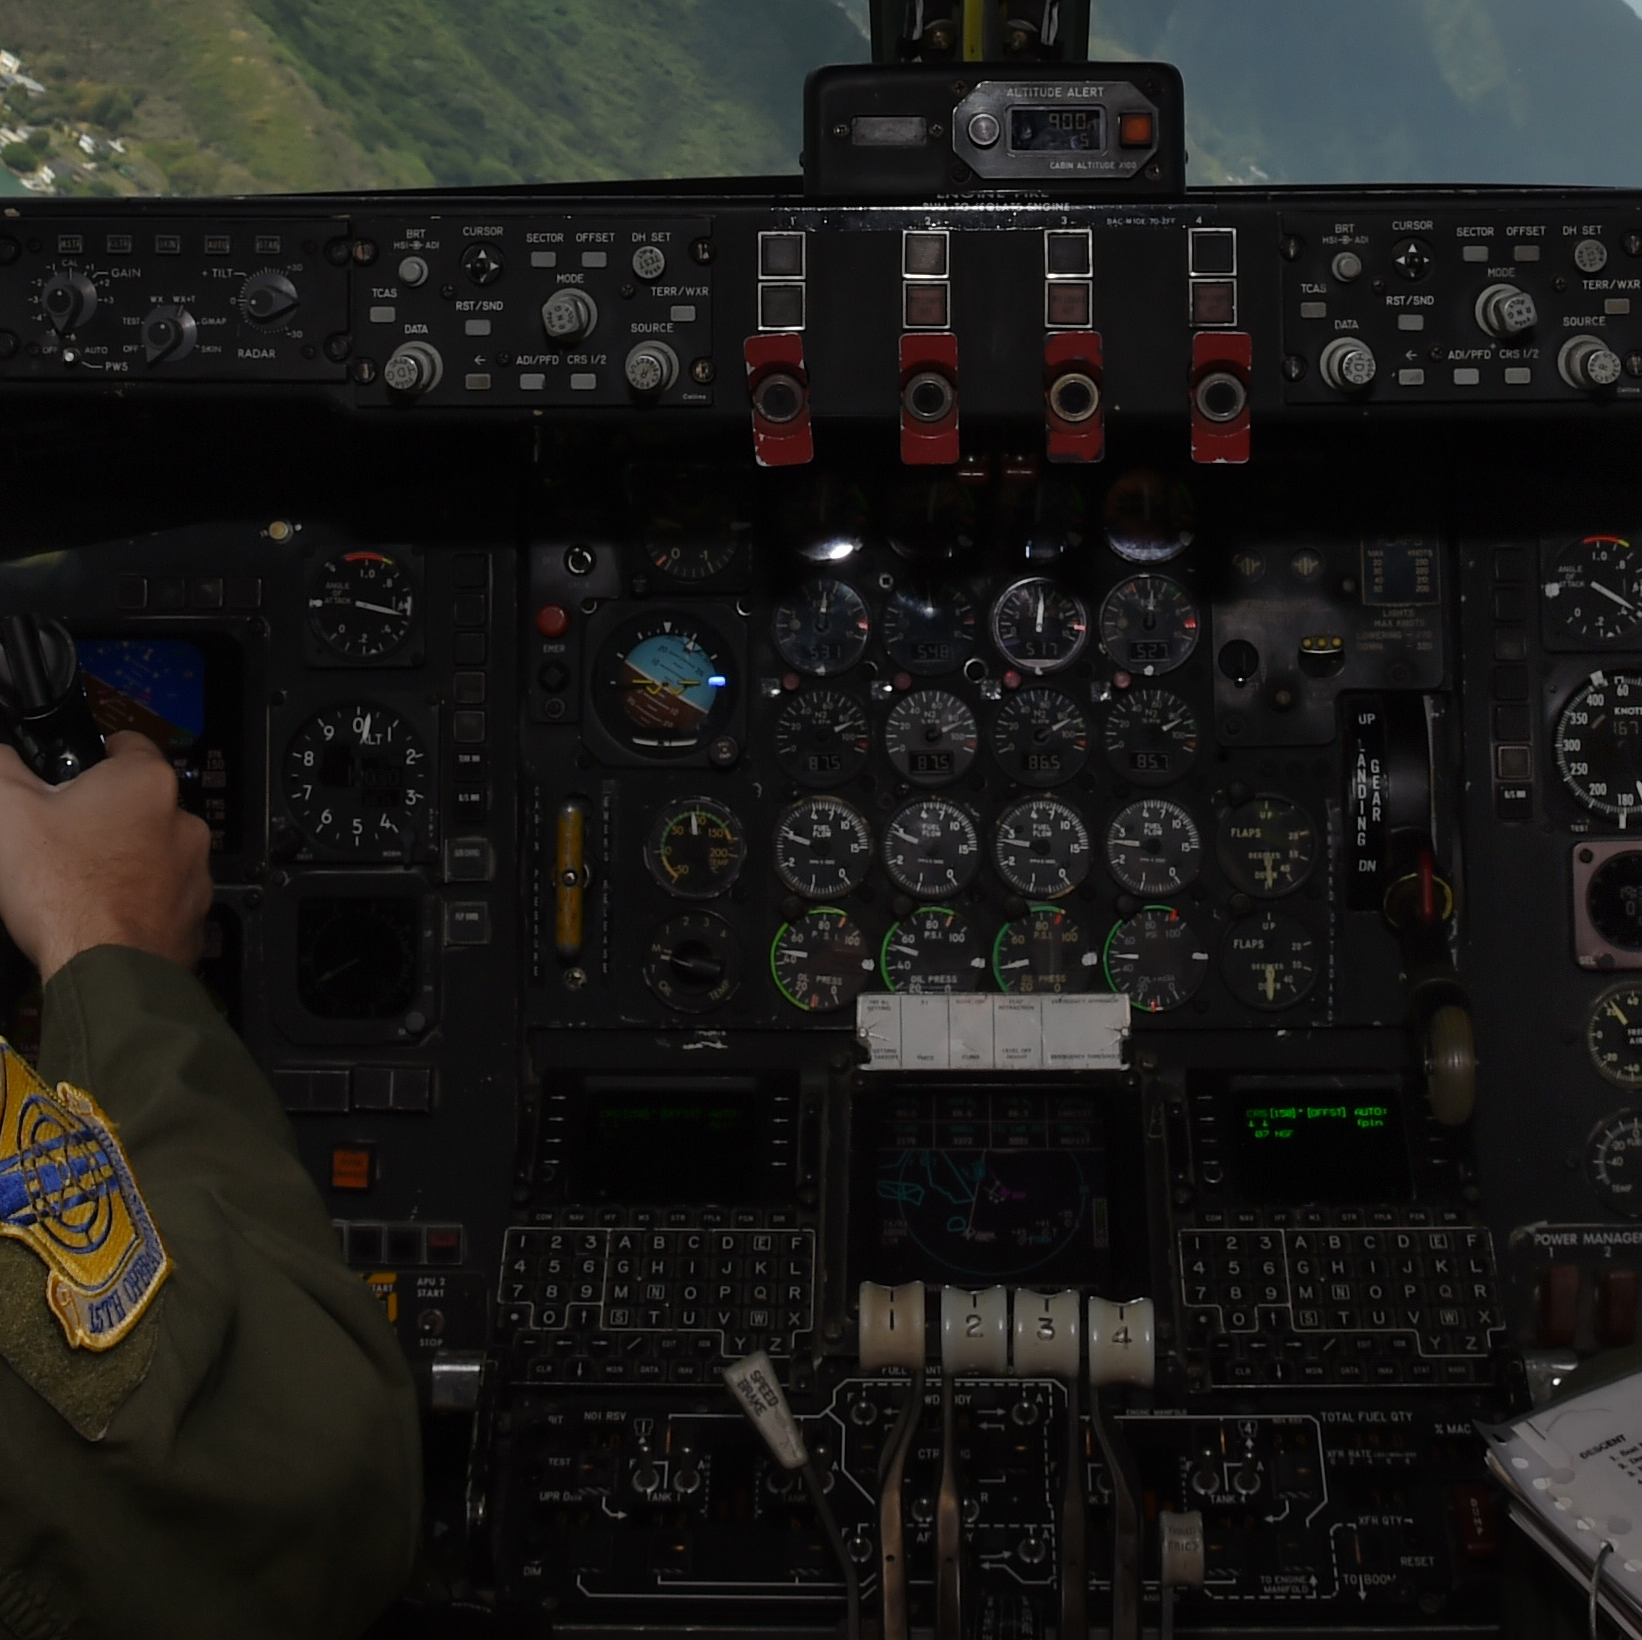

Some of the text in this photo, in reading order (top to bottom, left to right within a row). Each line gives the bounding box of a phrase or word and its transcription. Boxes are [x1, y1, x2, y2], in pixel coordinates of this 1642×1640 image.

[1007, 87, 1103, 98] ALTITUDE ALERT
[1392, 220, 1433, 230] CURSOR
[406, 229, 426, 239] BRT
[463, 226, 503, 236] CURSOR
[1457, 227, 1494, 237] SECTOR
[1506, 226, 1546, 236] OFFSET
[526, 233, 564, 243] SECTOR
[576, 233, 615, 242] OFFSET
[632, 232, 671, 242] DH SET
[111, 268, 141, 278] GAIN
[1488, 267, 1515, 277] MODE
[557, 274, 584, 283] MODE
[1301, 284, 1327, 293] TCAS
[1582, 279, 1640, 290] TERR/WXR
[372, 288, 397, 298] TCAS
[651, 286, 708, 296] TERR/WXR
[1386, 295, 1434, 305] RST/SND
[456, 301, 503, 311] RST/SND
[1335, 320, 1359, 330] DATA
[1563, 316, 1606, 326] SOURCE
[405, 324, 428, 334] DATA
[631, 323, 673, 333] SOURCE
[238, 349, 275, 358] RADAR
[1448, 350, 1491, 360] ADI/PFD
[516, 355, 559, 365] ADI/PFD
[106, 362, 128, 371] PWS
[1358, 713, 1375, 724] UP
[1357, 739, 1366, 846] LANDING
[1371, 759, 1382, 821] GEAR
[1231, 828, 1261, 838] FLAPS
[1359, 860, 1376, 872] DN
[1234, 939, 1264, 949] FLAPS
[1535, 1234, 1577, 1245] POWER
[965, 1313, 984, 1339] 2
[1037, 1317, 1055, 1342] 3
[1111, 1324, 1133, 1349] 4
[750, 1370, 779, 1407] SPEED
[737, 1380, 765, 1416] BRAKE
[1320, 1411, 1412, 1422] TOTAL FUEL QTY
[1578, 1435, 1627, 1460] DESCENT
